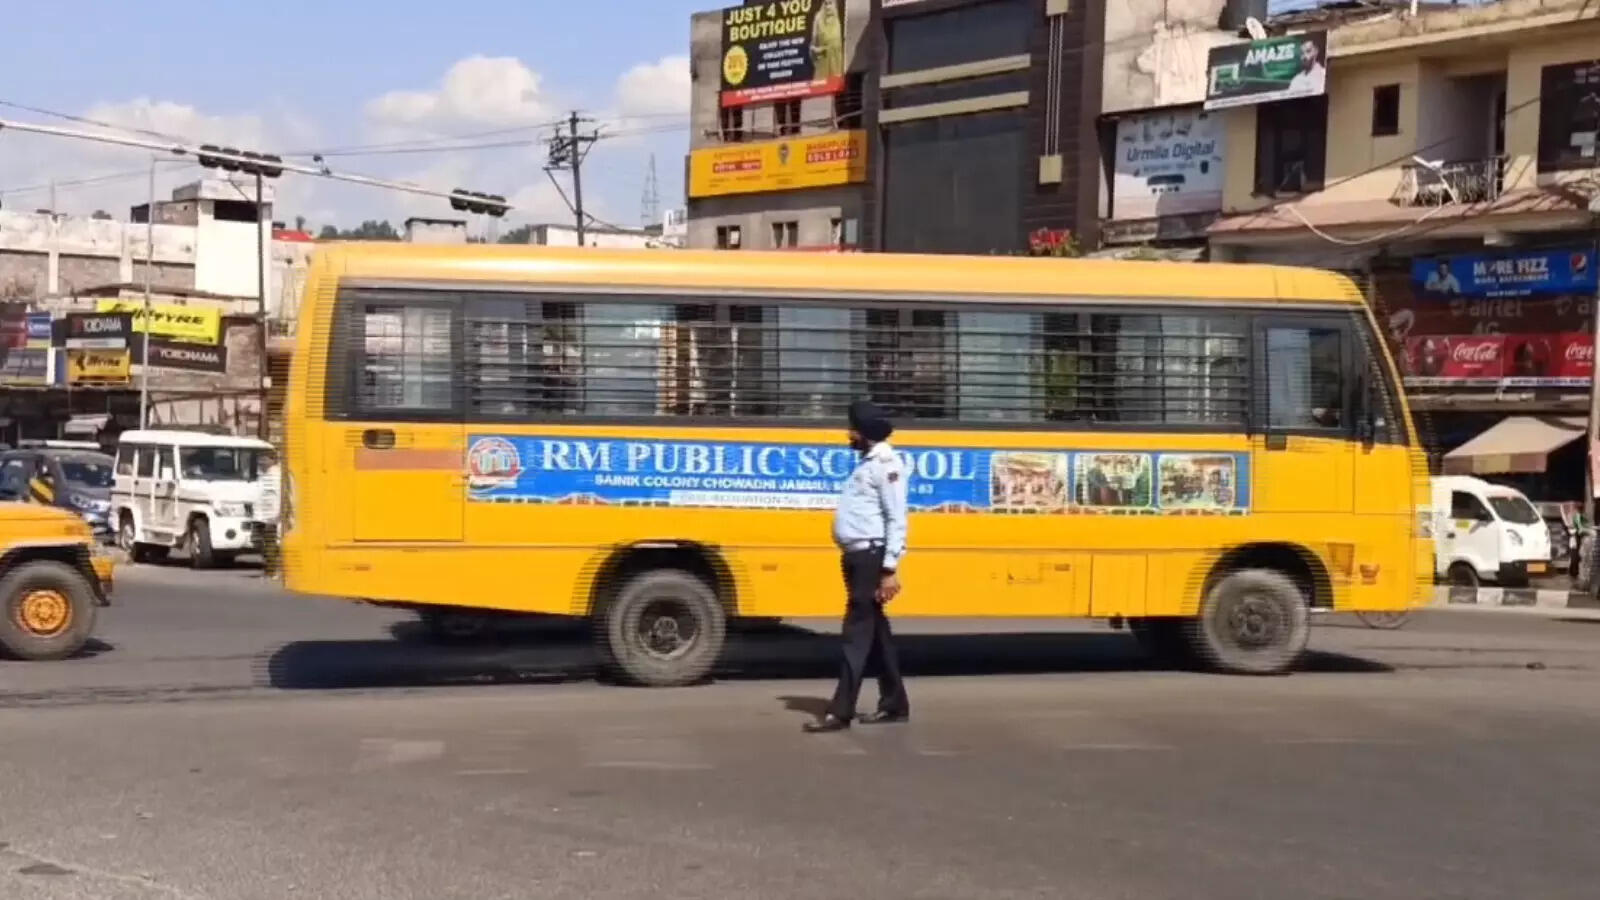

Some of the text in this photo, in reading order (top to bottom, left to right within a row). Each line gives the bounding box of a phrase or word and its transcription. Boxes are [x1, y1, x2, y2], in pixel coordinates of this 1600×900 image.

[726, 0, 812, 26] JUST 4 YOU
[729, 16, 807, 42] BOUTIQUE
[1244, 43, 1296, 66] AMAZE
[1126, 140, 1215, 162] Urmila Digital
[1516, 257, 1549, 273] FIZZ
[158, 349, 219, 363] YOKOHAMA
[541, 440, 612, 471] RM
[626, 442, 786, 477] PUBLIC
[798, 446, 975, 481] SCOL
[595, 475, 640, 487] SAINIK
[644, 476, 699, 488] COLONY
